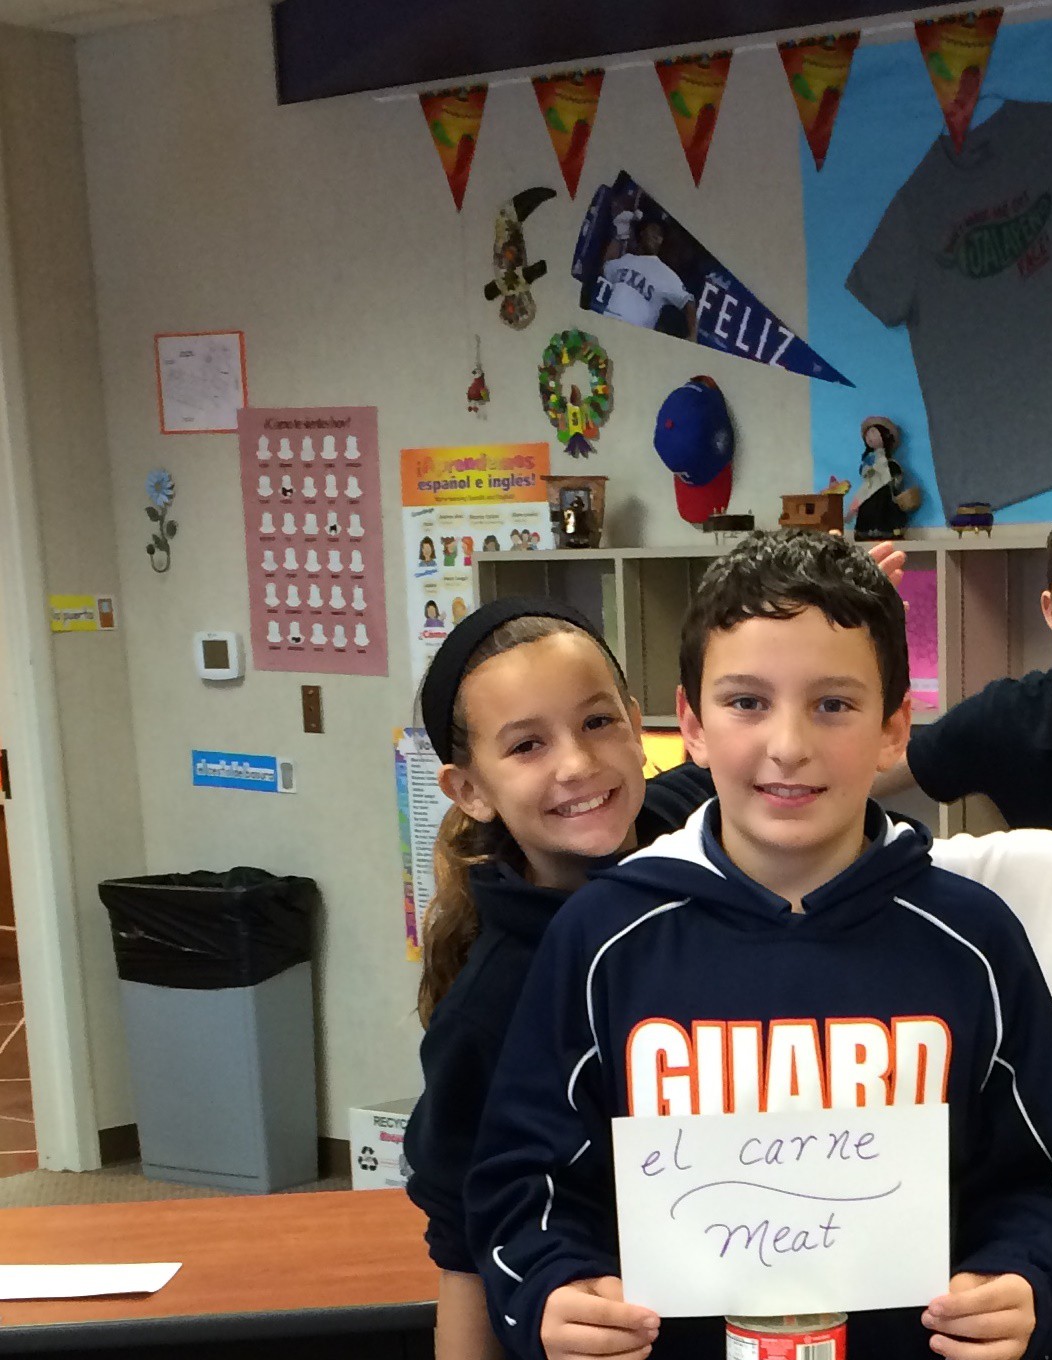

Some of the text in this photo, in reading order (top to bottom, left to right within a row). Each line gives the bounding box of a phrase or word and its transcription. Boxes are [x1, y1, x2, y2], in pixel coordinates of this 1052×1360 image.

[697, 280, 796, 369] FELIZ
[418, 475, 471, 493] español
[626, 1016, 953, 1116] GUARD
[641, 1128, 880, 1177] el carne
